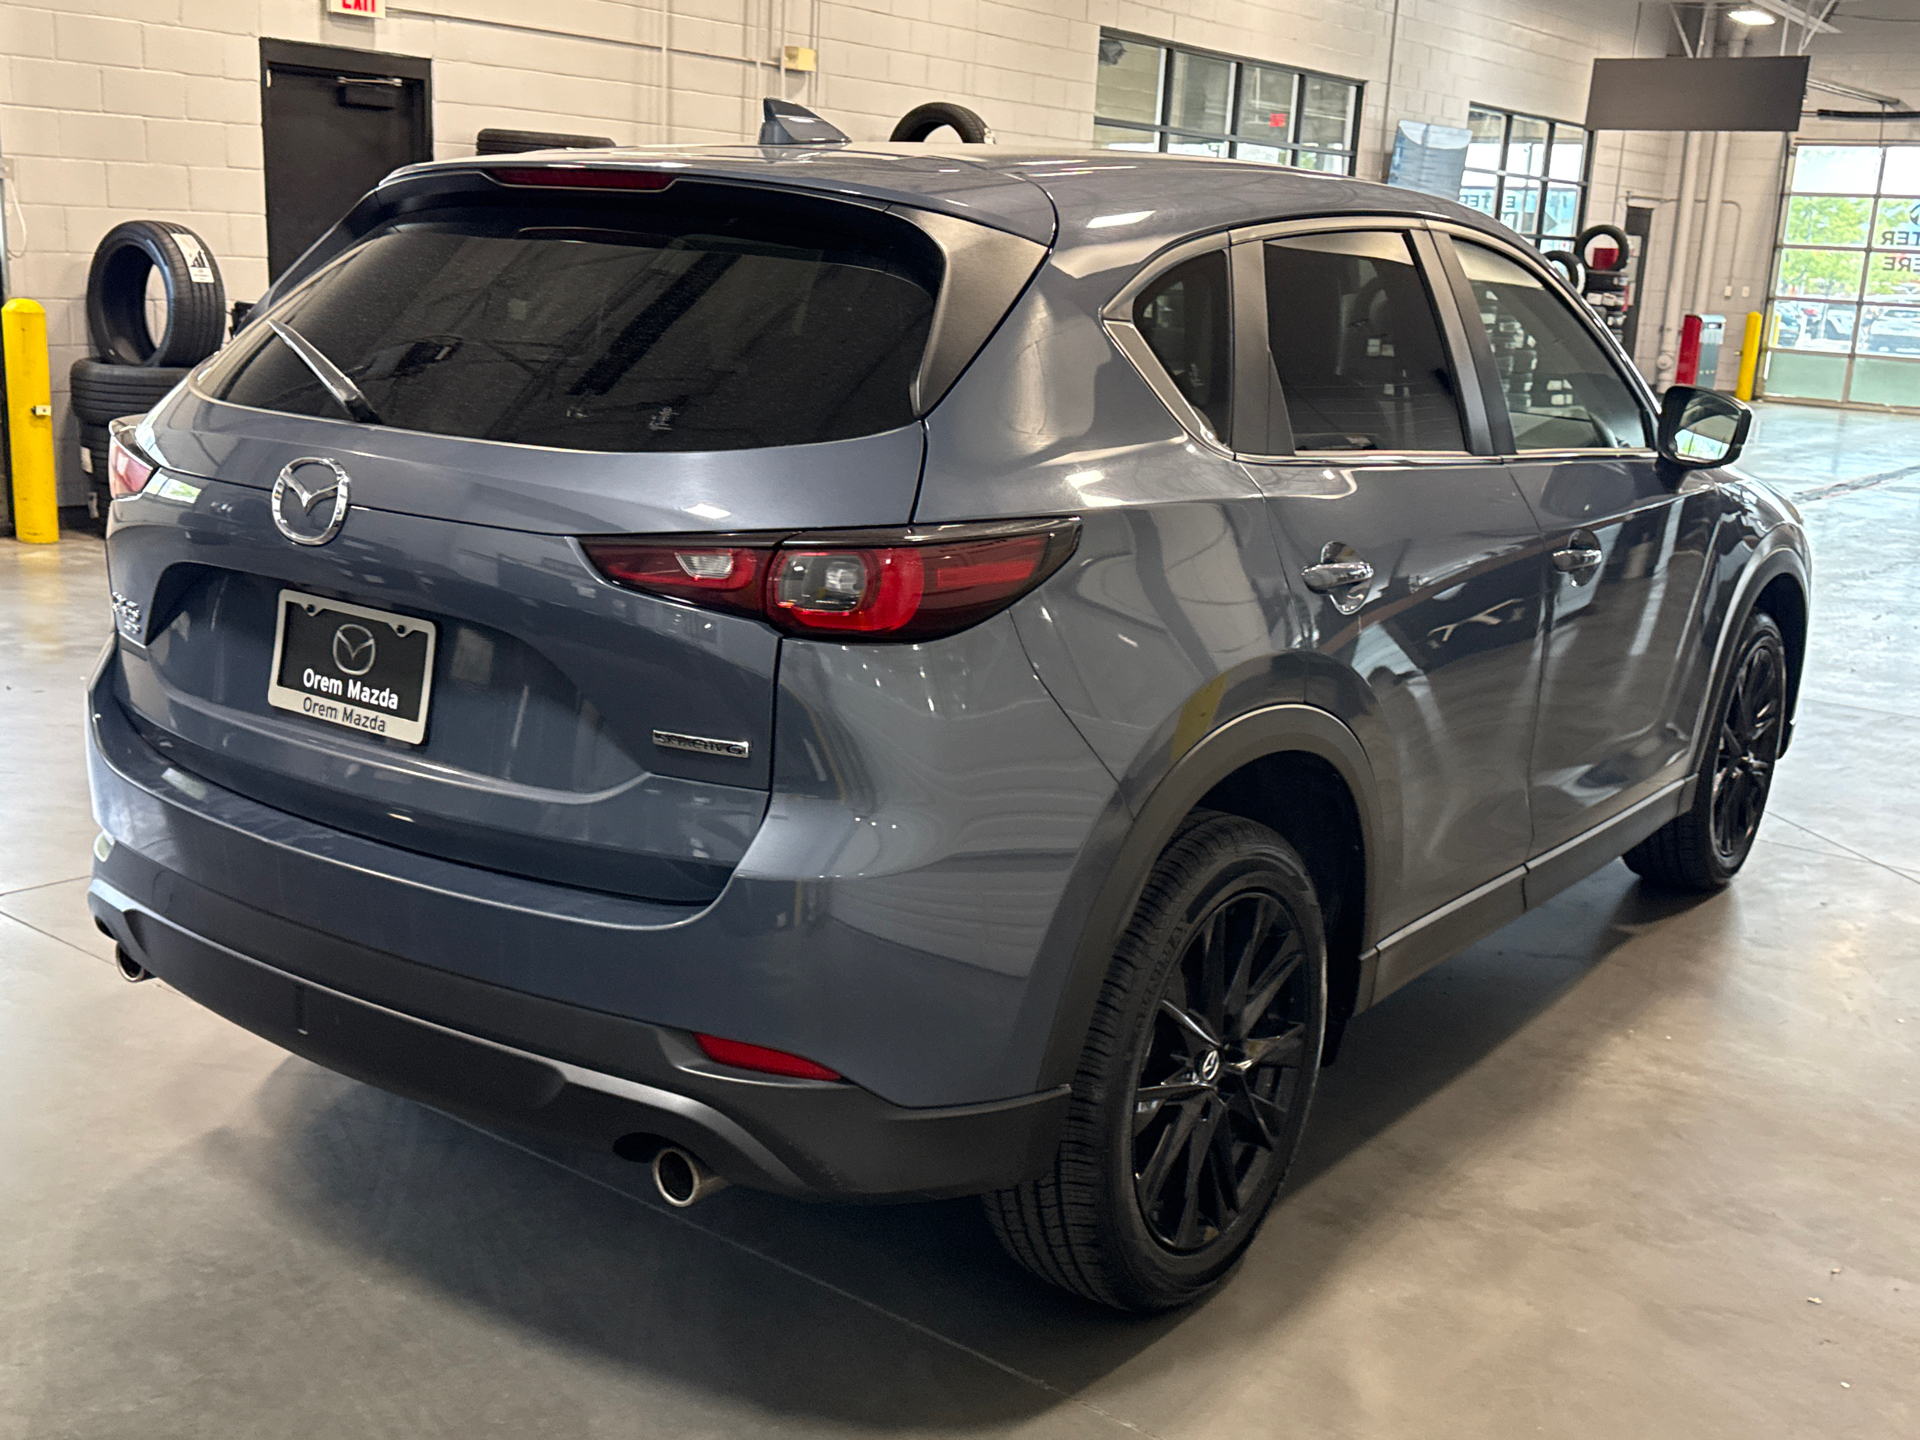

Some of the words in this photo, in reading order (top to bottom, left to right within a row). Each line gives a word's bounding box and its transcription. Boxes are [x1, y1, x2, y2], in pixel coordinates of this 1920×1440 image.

[303, 668, 343, 696] Orem
[347, 679, 399, 710] Mazda
[303, 697, 338, 720] Orem
[342, 707, 386, 733] Mazda
